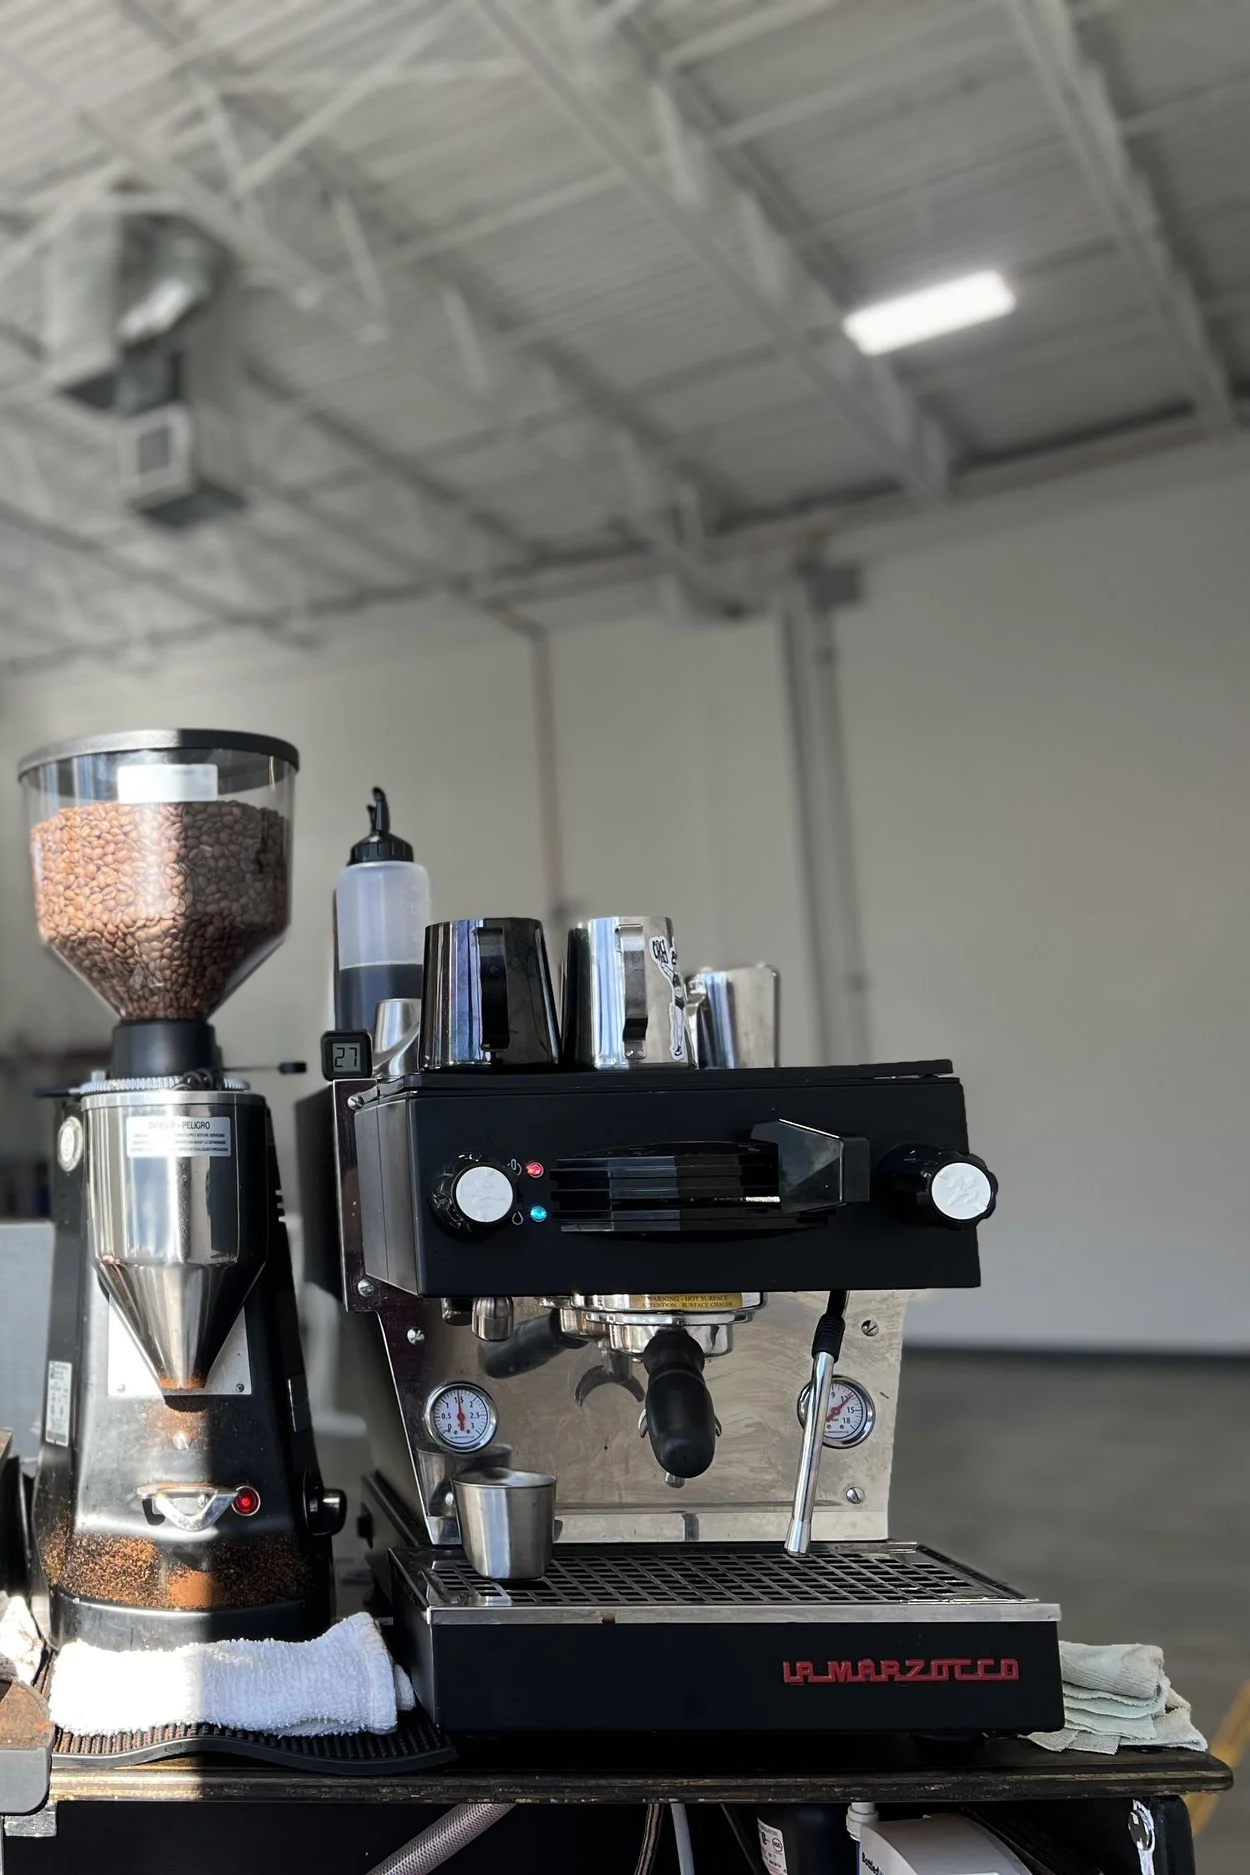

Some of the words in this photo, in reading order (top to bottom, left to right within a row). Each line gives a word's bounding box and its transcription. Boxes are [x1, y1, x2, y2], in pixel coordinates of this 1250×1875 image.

[335, 1046, 358, 1068] 27
[182, 1121, 210, 1130] PELIGRO
[847, 1406, 855, 1414] 15
[827, 1658, 1020, 1683] MARZOCCO
